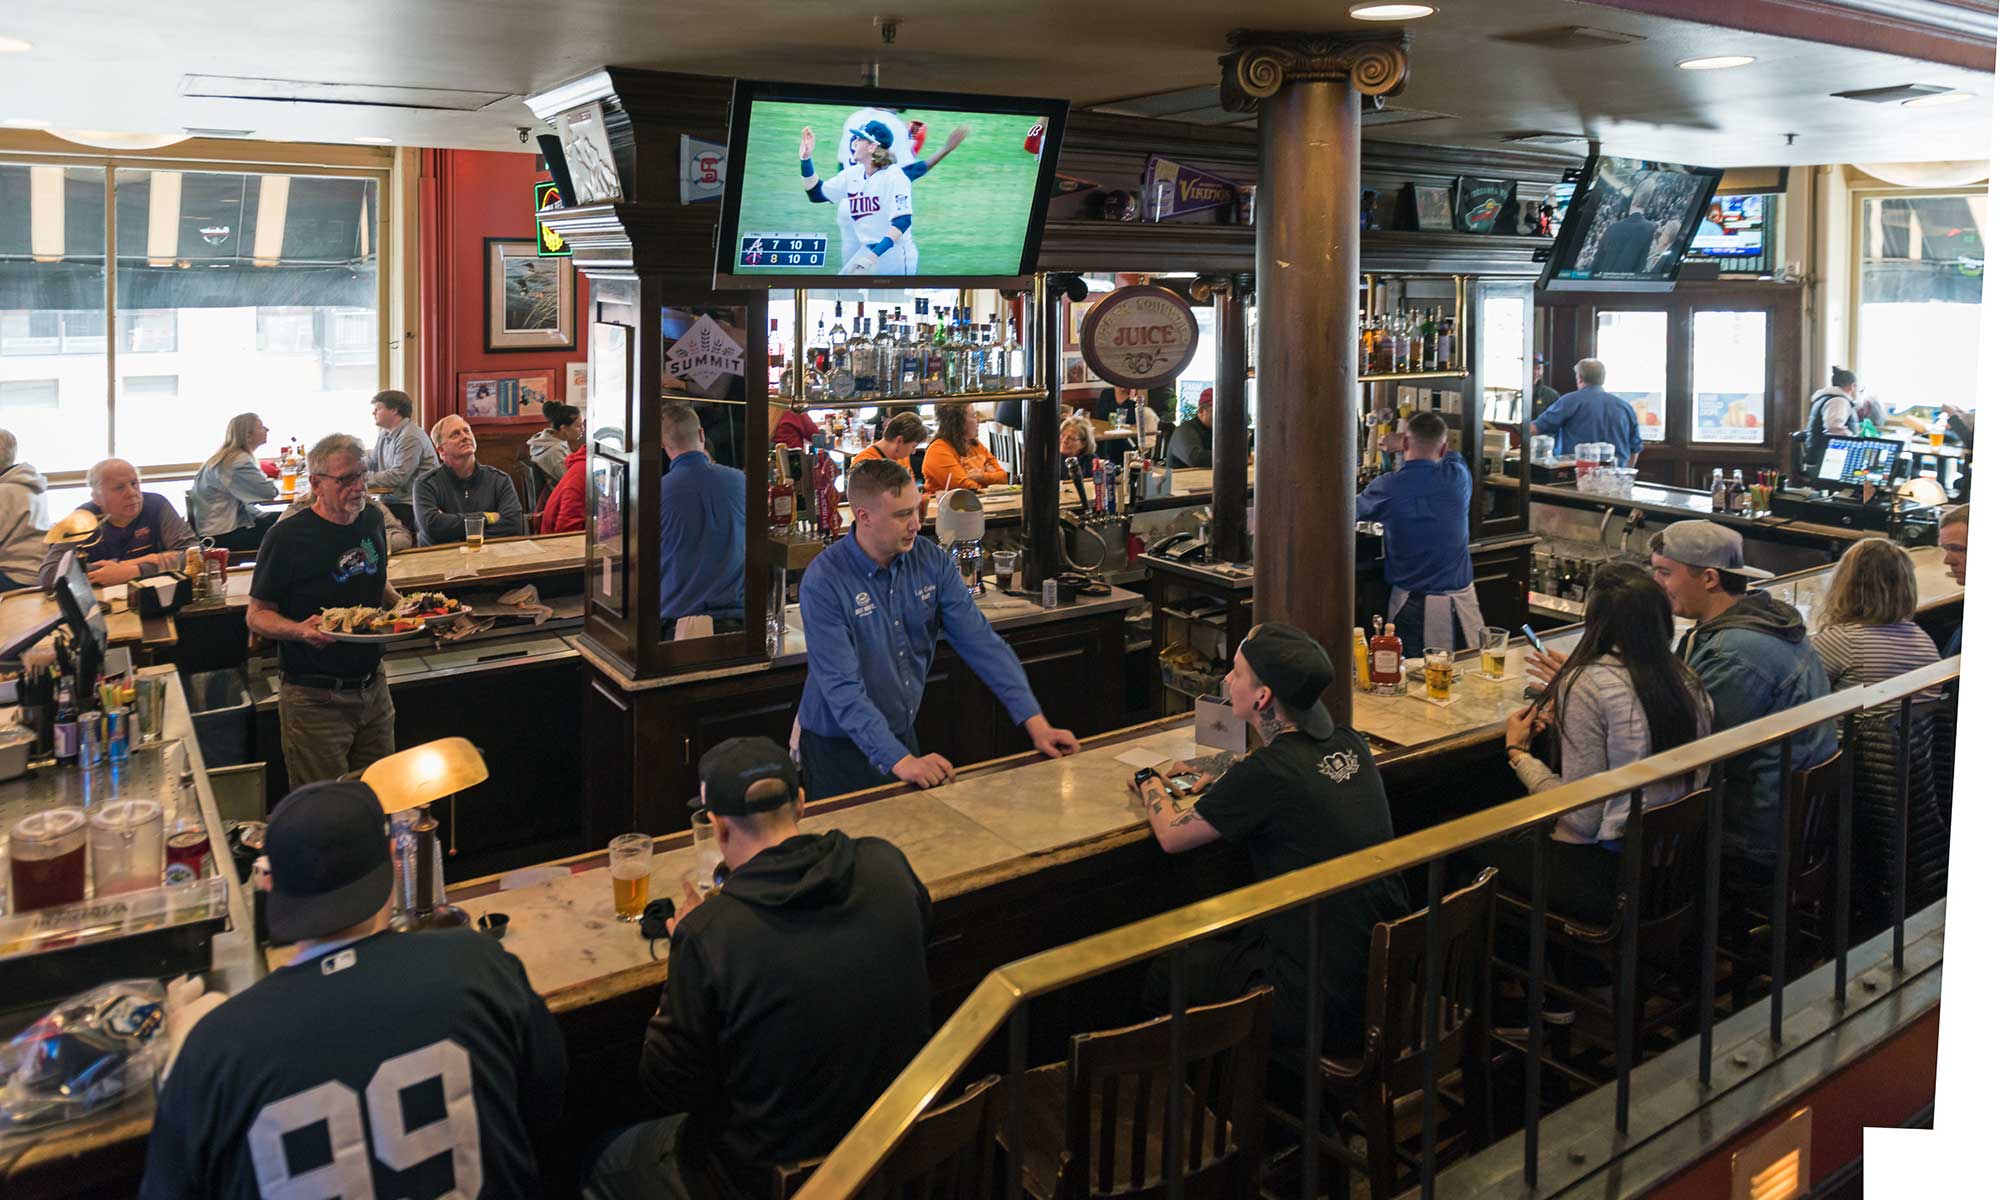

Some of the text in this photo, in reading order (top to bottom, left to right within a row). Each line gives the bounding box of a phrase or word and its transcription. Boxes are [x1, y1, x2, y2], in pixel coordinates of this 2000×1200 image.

[772, 240, 779, 250] 7
[790, 240, 802, 250] 10
[813, 240, 818, 250] 1
[770, 254, 817, 264] 8 10 0
[1113, 324, 1177, 346] JUICE
[670, 354, 740, 374] SUMMIT
